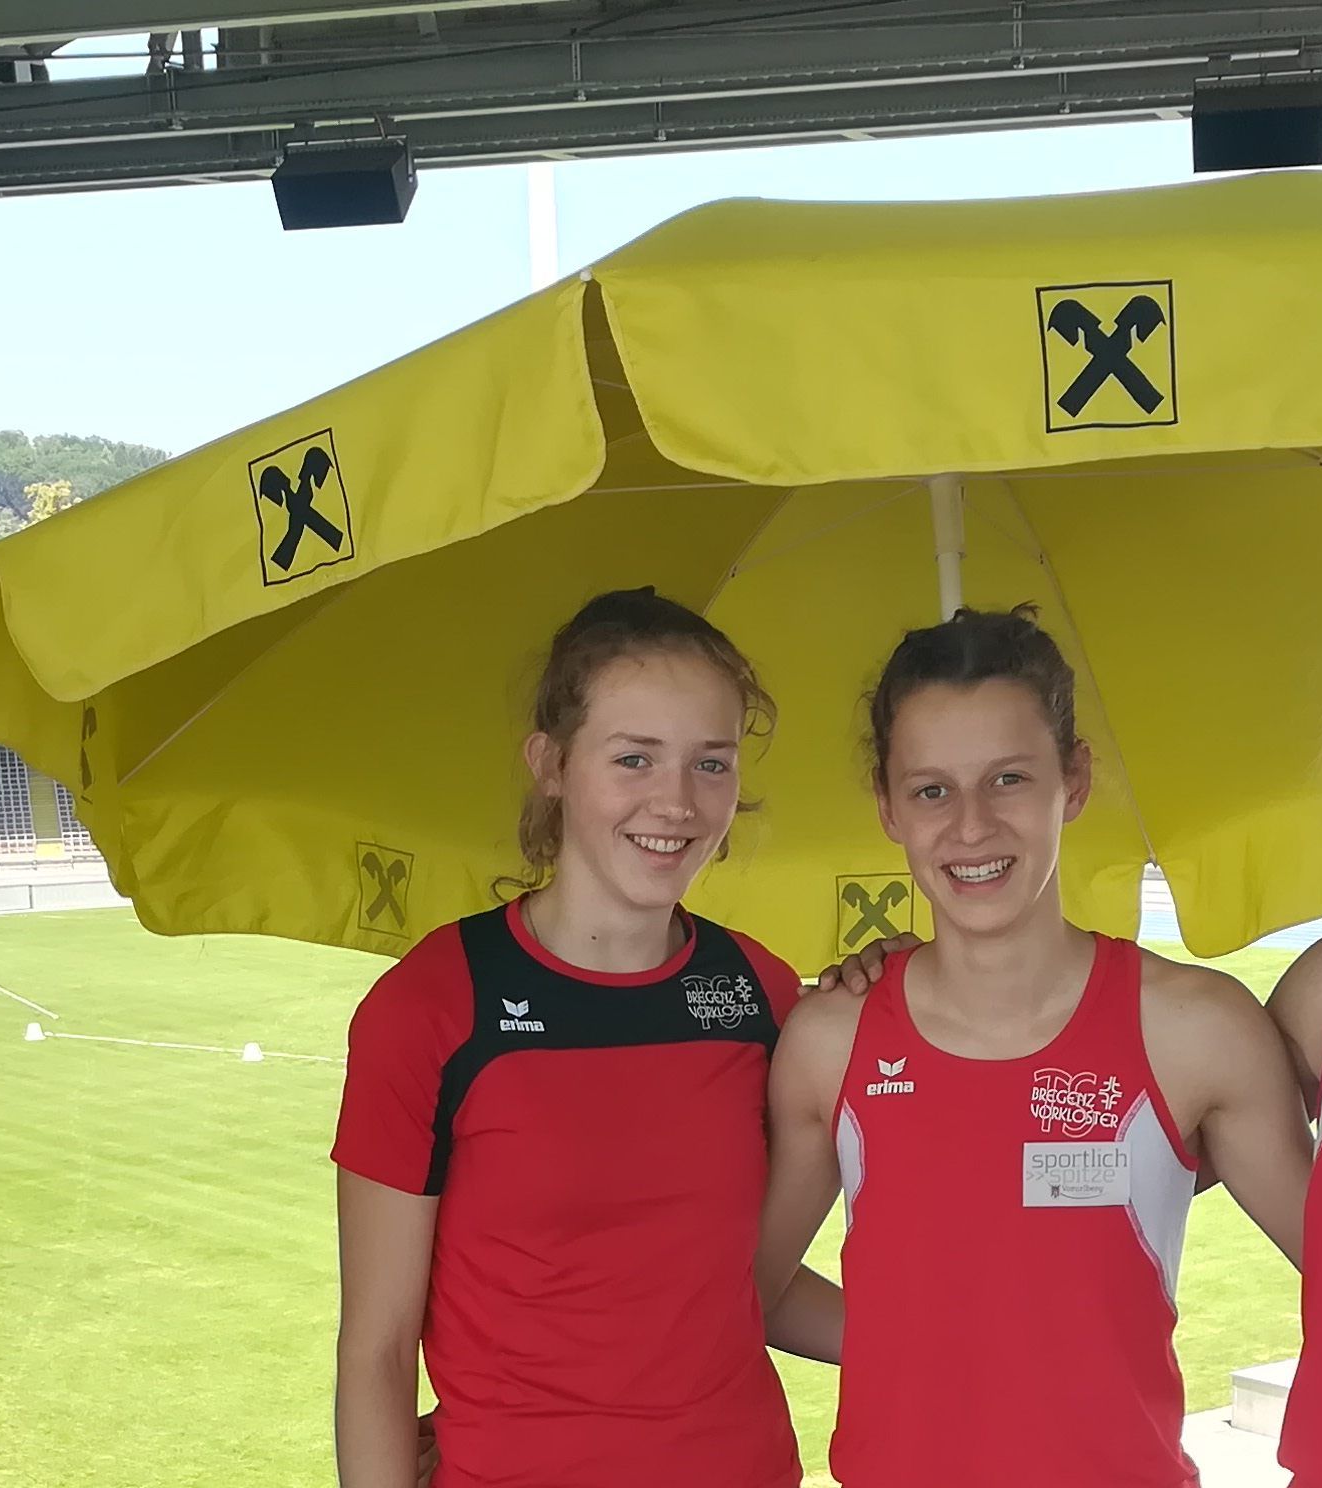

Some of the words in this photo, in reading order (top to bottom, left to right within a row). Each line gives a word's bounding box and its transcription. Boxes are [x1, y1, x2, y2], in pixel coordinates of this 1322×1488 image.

[685, 990, 736, 1005] BREGENZ
[688, 1003, 760, 1019] VORKLOSTER
[499, 1017, 545, 1033] erima
[866, 1079, 915, 1096] erima
[1031, 1086, 1096, 1108] BREGENZ
[1030, 1103, 1119, 1129] VORKLOSTER
[1031, 1148, 1128, 1173] sportlich
[1049, 1166, 1116, 1184] spitze
